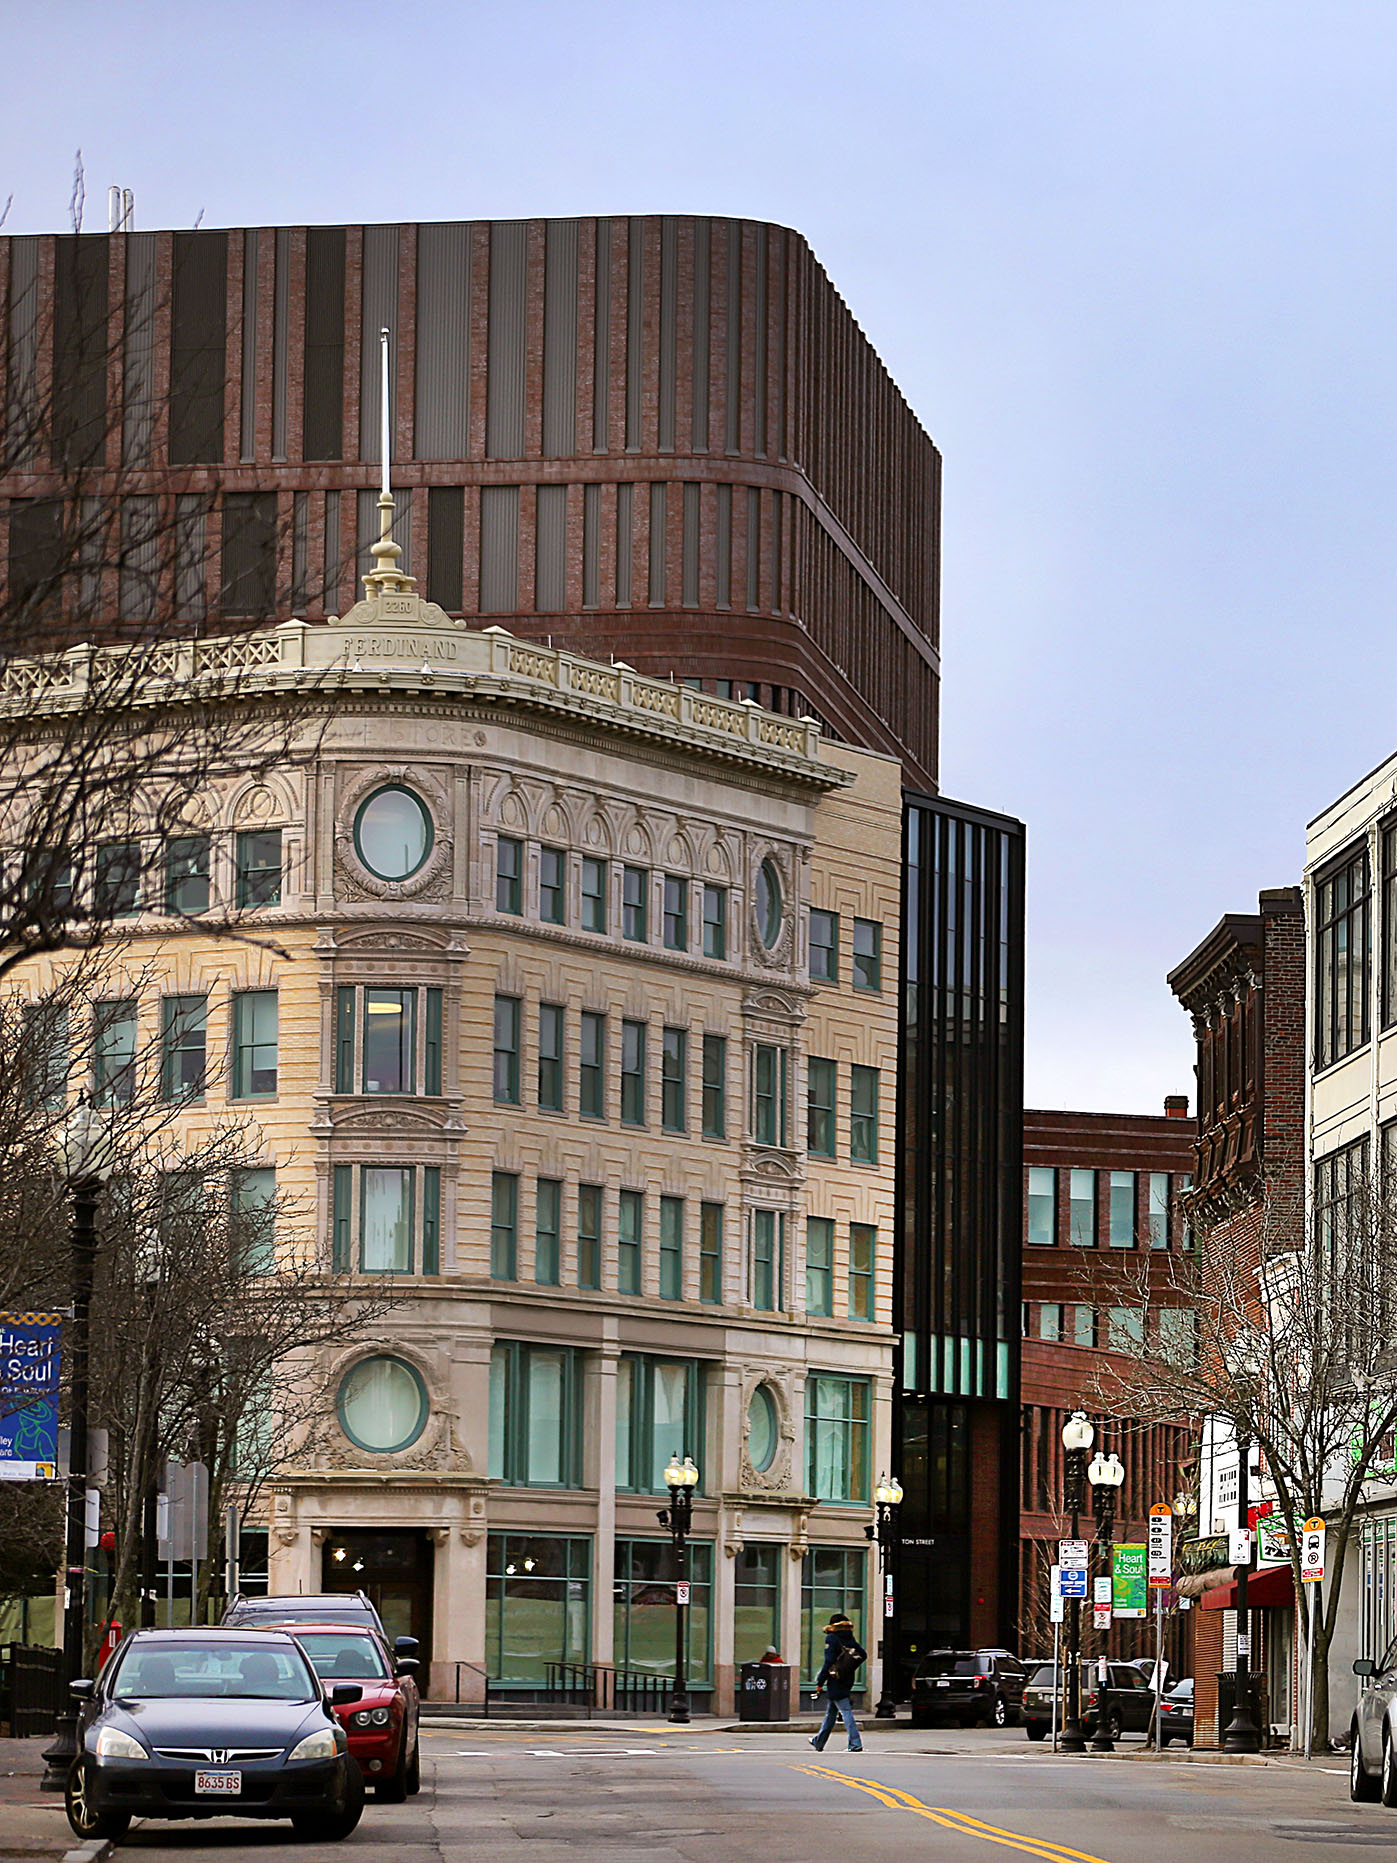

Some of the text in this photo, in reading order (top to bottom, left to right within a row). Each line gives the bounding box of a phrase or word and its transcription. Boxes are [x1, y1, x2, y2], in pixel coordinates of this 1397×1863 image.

[385, 601, 413, 614] 2260
[342, 637, 458, 660] FERDINAND
[1118, 1554, 1143, 1563] Heart
[1114, 1564, 1143, 1574] & Soul
[198, 1776, 240, 1789] 8635 BS
